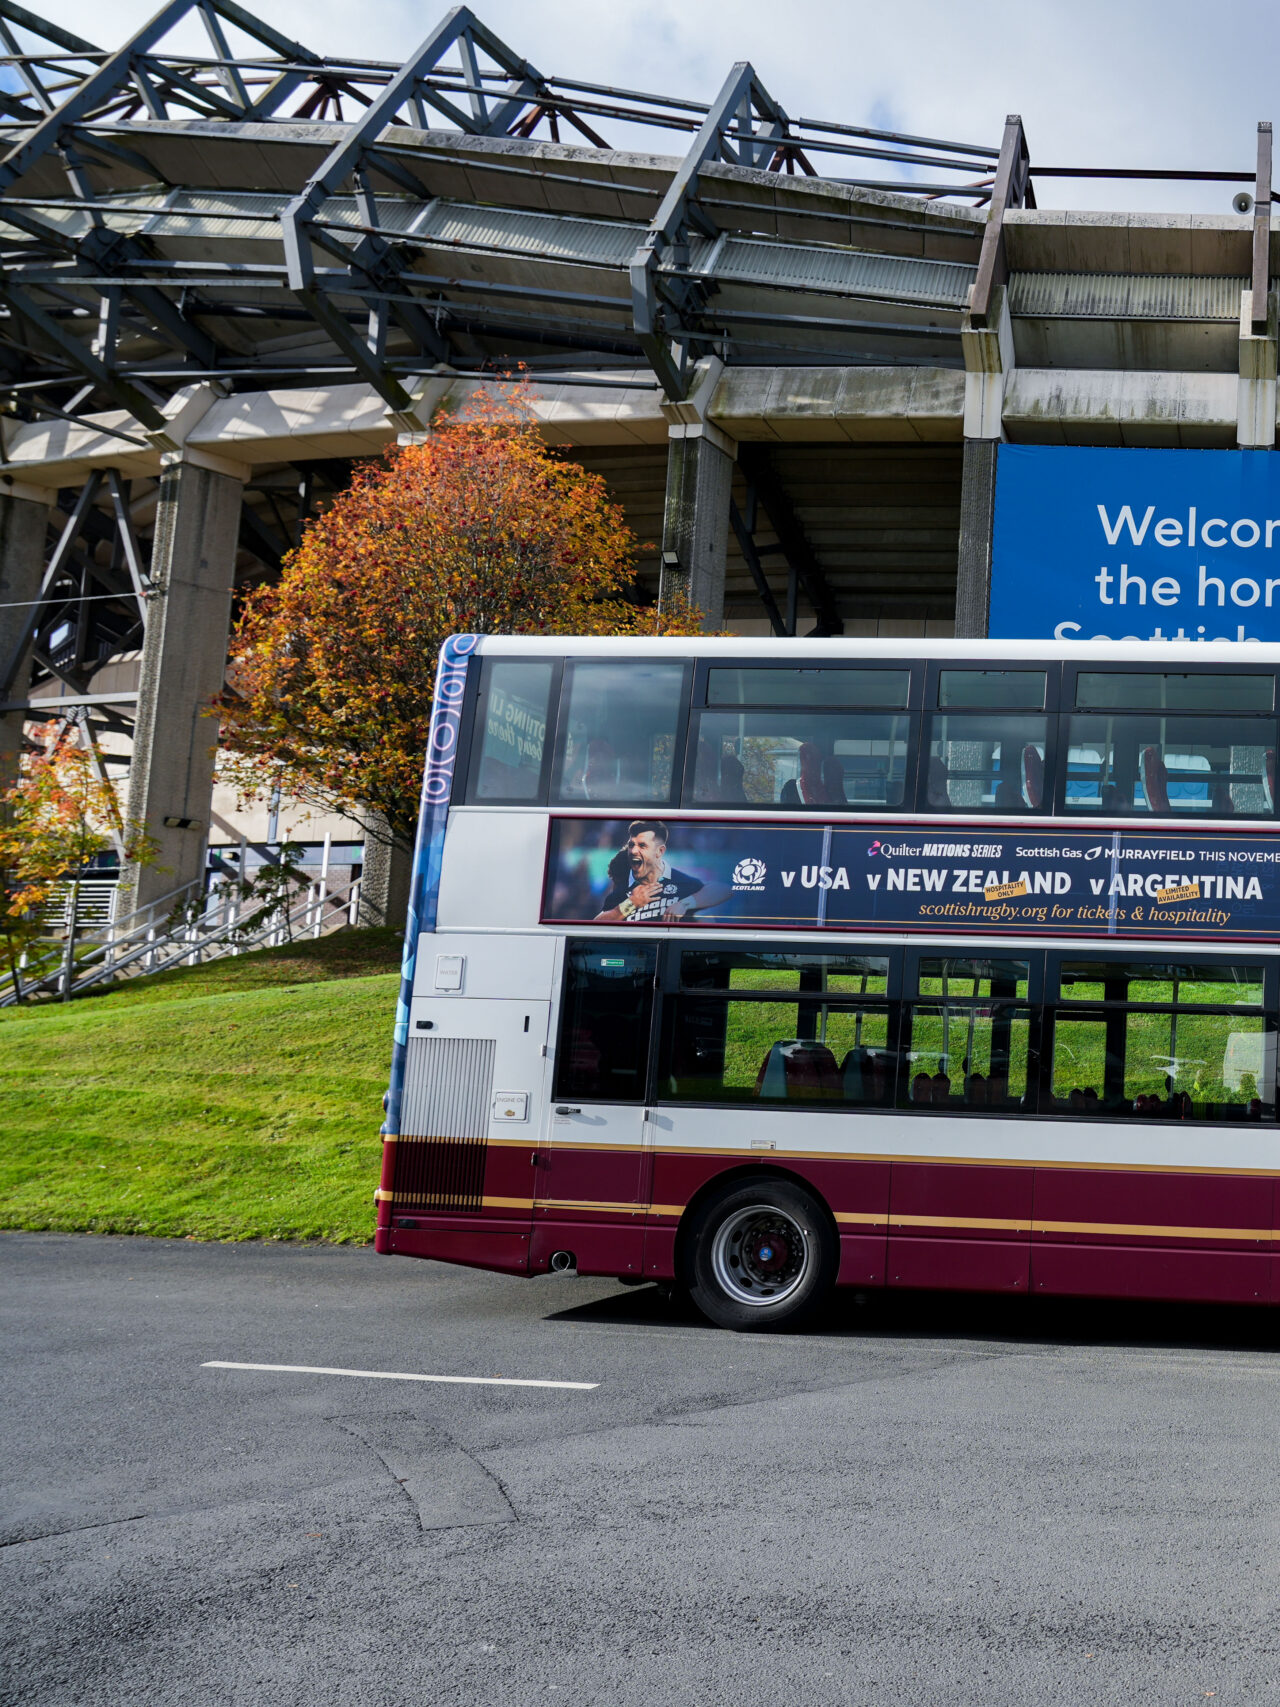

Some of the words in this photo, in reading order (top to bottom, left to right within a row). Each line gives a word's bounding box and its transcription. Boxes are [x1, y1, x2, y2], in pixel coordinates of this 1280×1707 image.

[1095, 564, 1181, 606] the
[880, 843, 922, 858] Quilter
[922, 843, 971, 858] NATIONS
[971, 844, 1003, 858] SERIES
[1016, 846, 1060, 858] Scottish
[1061, 847, 1083, 858] Gas
[1104, 848, 1195, 861] MURRAYFIELD
[1198, 850, 1226, 862] THIS
[780, 871, 796, 888] v
[800, 865, 851, 890] USA
[866, 873, 882, 890] v
[886, 868, 949, 892] NEW
[1089, 878, 1105, 896] v
[1107, 873, 1264, 900] ARGENTINA
[986, 881, 1025, 894] HOSPITALITY
[1165, 885, 1190, 895] LIMITED
[997, 889, 1014, 898] ONLY
[1158, 890, 1199, 903] AVAILABILITY
[918, 901, 1048, 922] scottishrugby.org
[1050, 904, 1074, 920] for
[1077, 904, 1126, 920] tickets
[1130, 906, 1144, 921] &
[1148, 906, 1231, 927] hospitality
